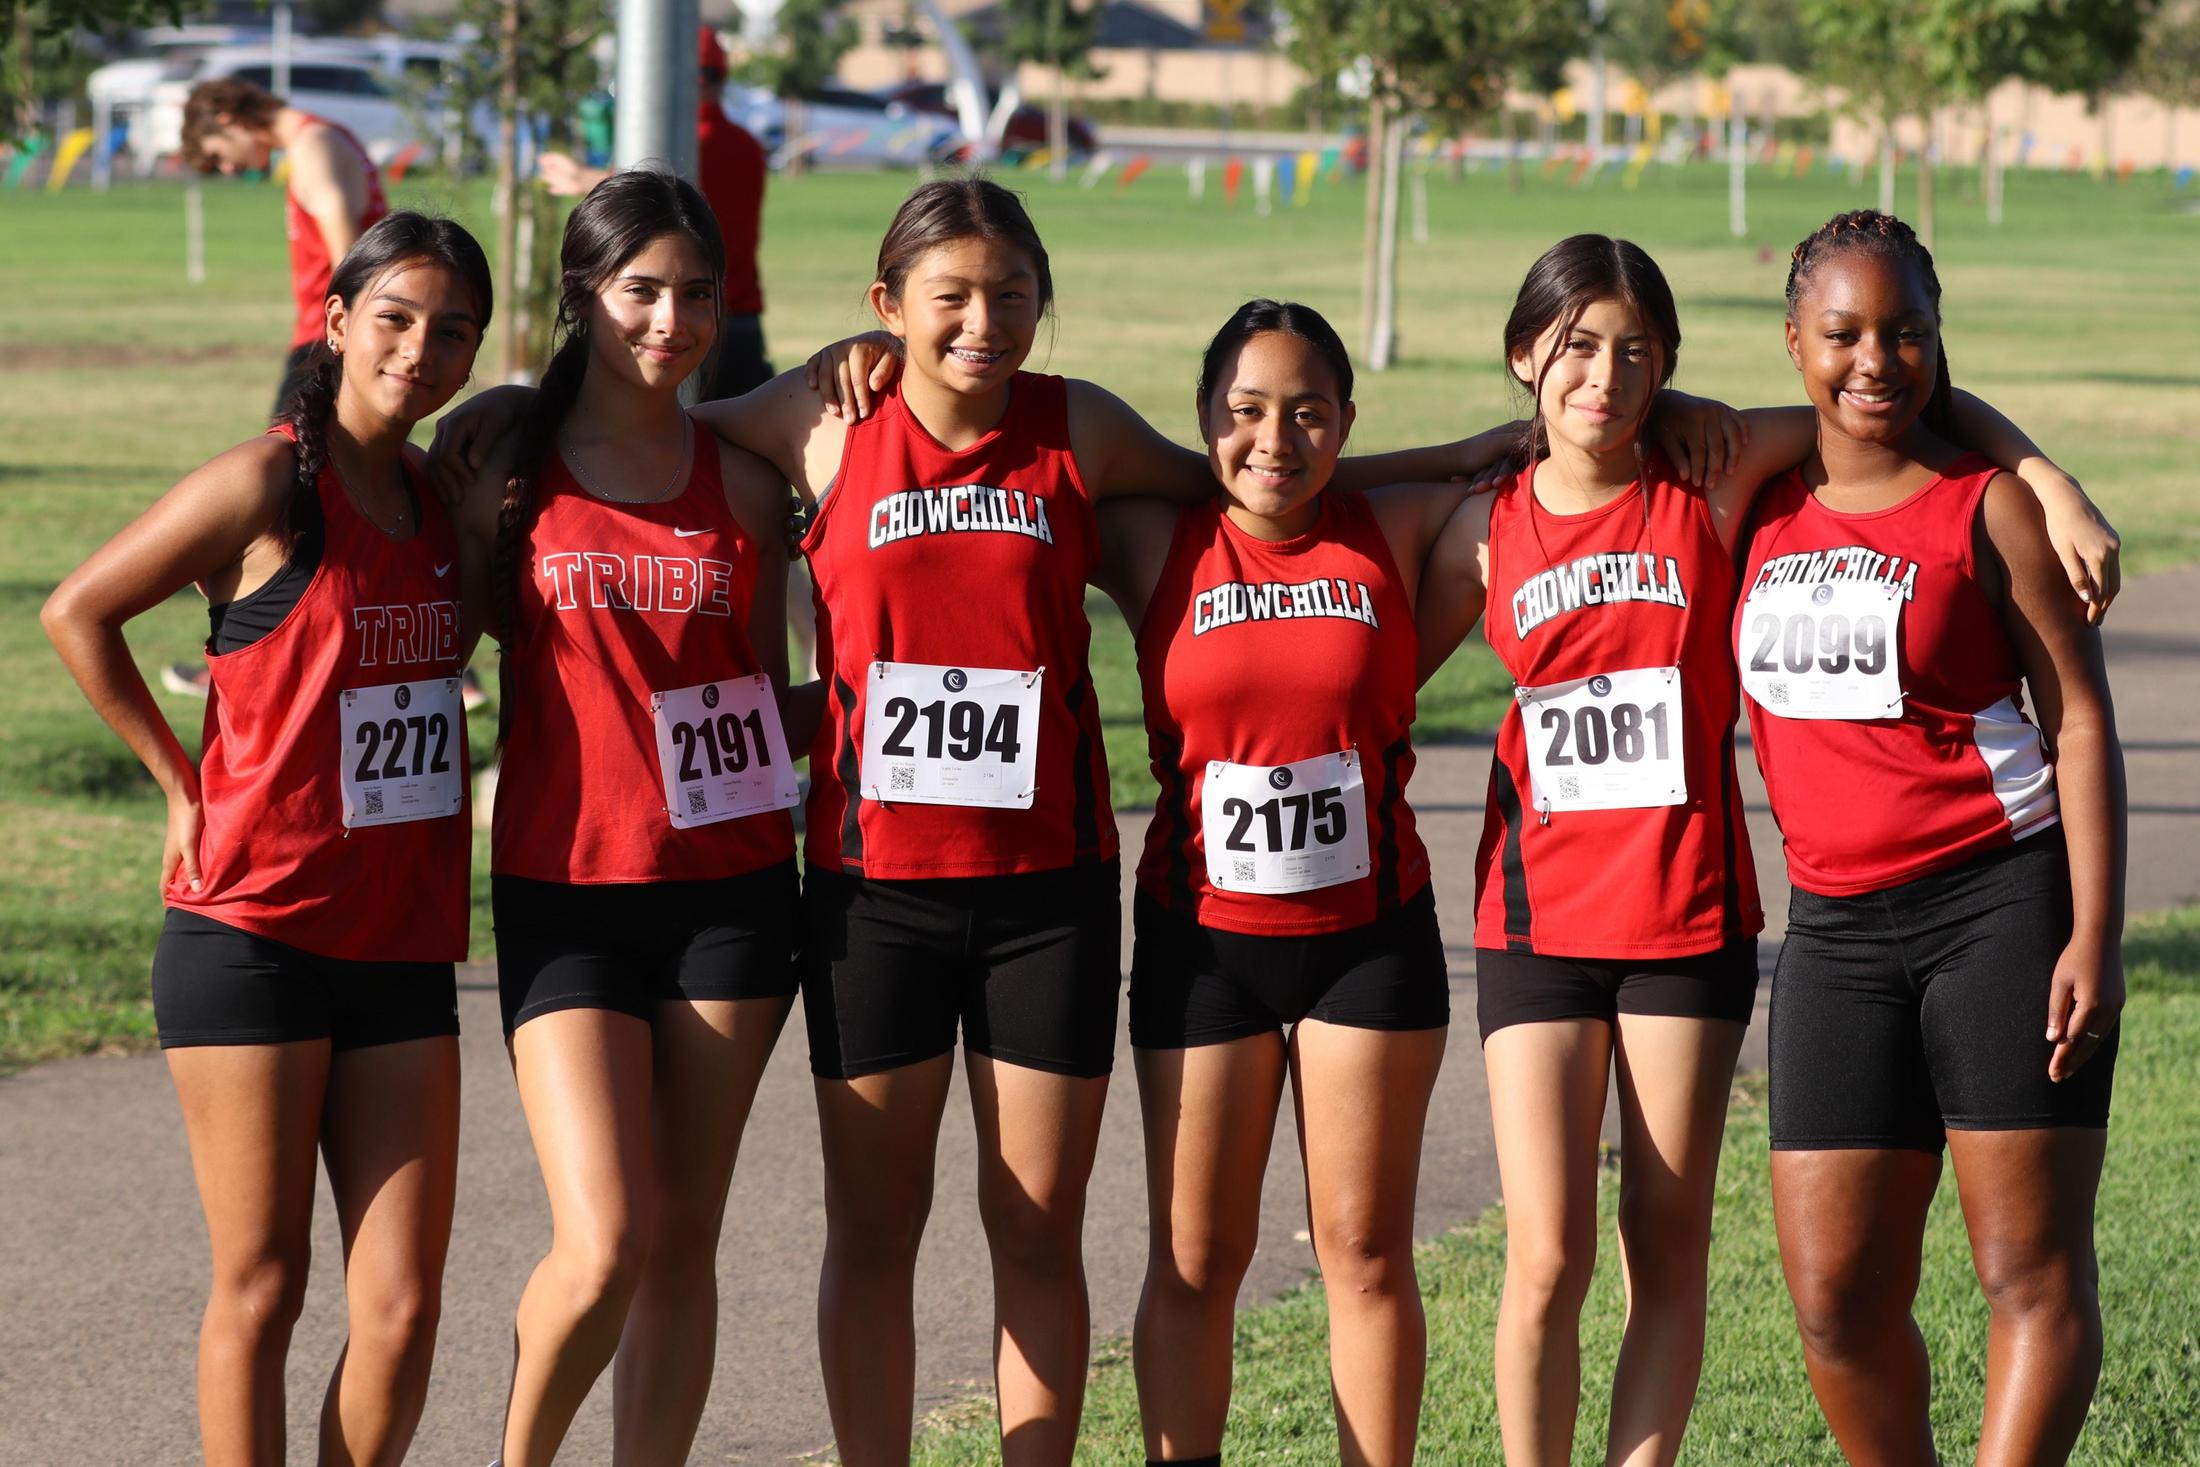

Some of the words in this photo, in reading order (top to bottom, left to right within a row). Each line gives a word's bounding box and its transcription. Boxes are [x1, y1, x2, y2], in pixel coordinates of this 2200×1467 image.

[868, 484, 1054, 550] CHOWCHILLA
[543, 552, 732, 616] TRIBE
[1193, 578, 1380, 637] CHOWCHILLA
[1512, 551, 1688, 641] CHOWCHILLA
[353, 600, 462, 667] TRIB
[1750, 613, 1887, 675] 2099
[355, 713, 449, 782] 2272
[672, 709, 771, 782] 2191
[882, 696, 1021, 763] 2194
[1541, 702, 1669, 766] 2081
[1223, 787, 1347, 852] 2175
